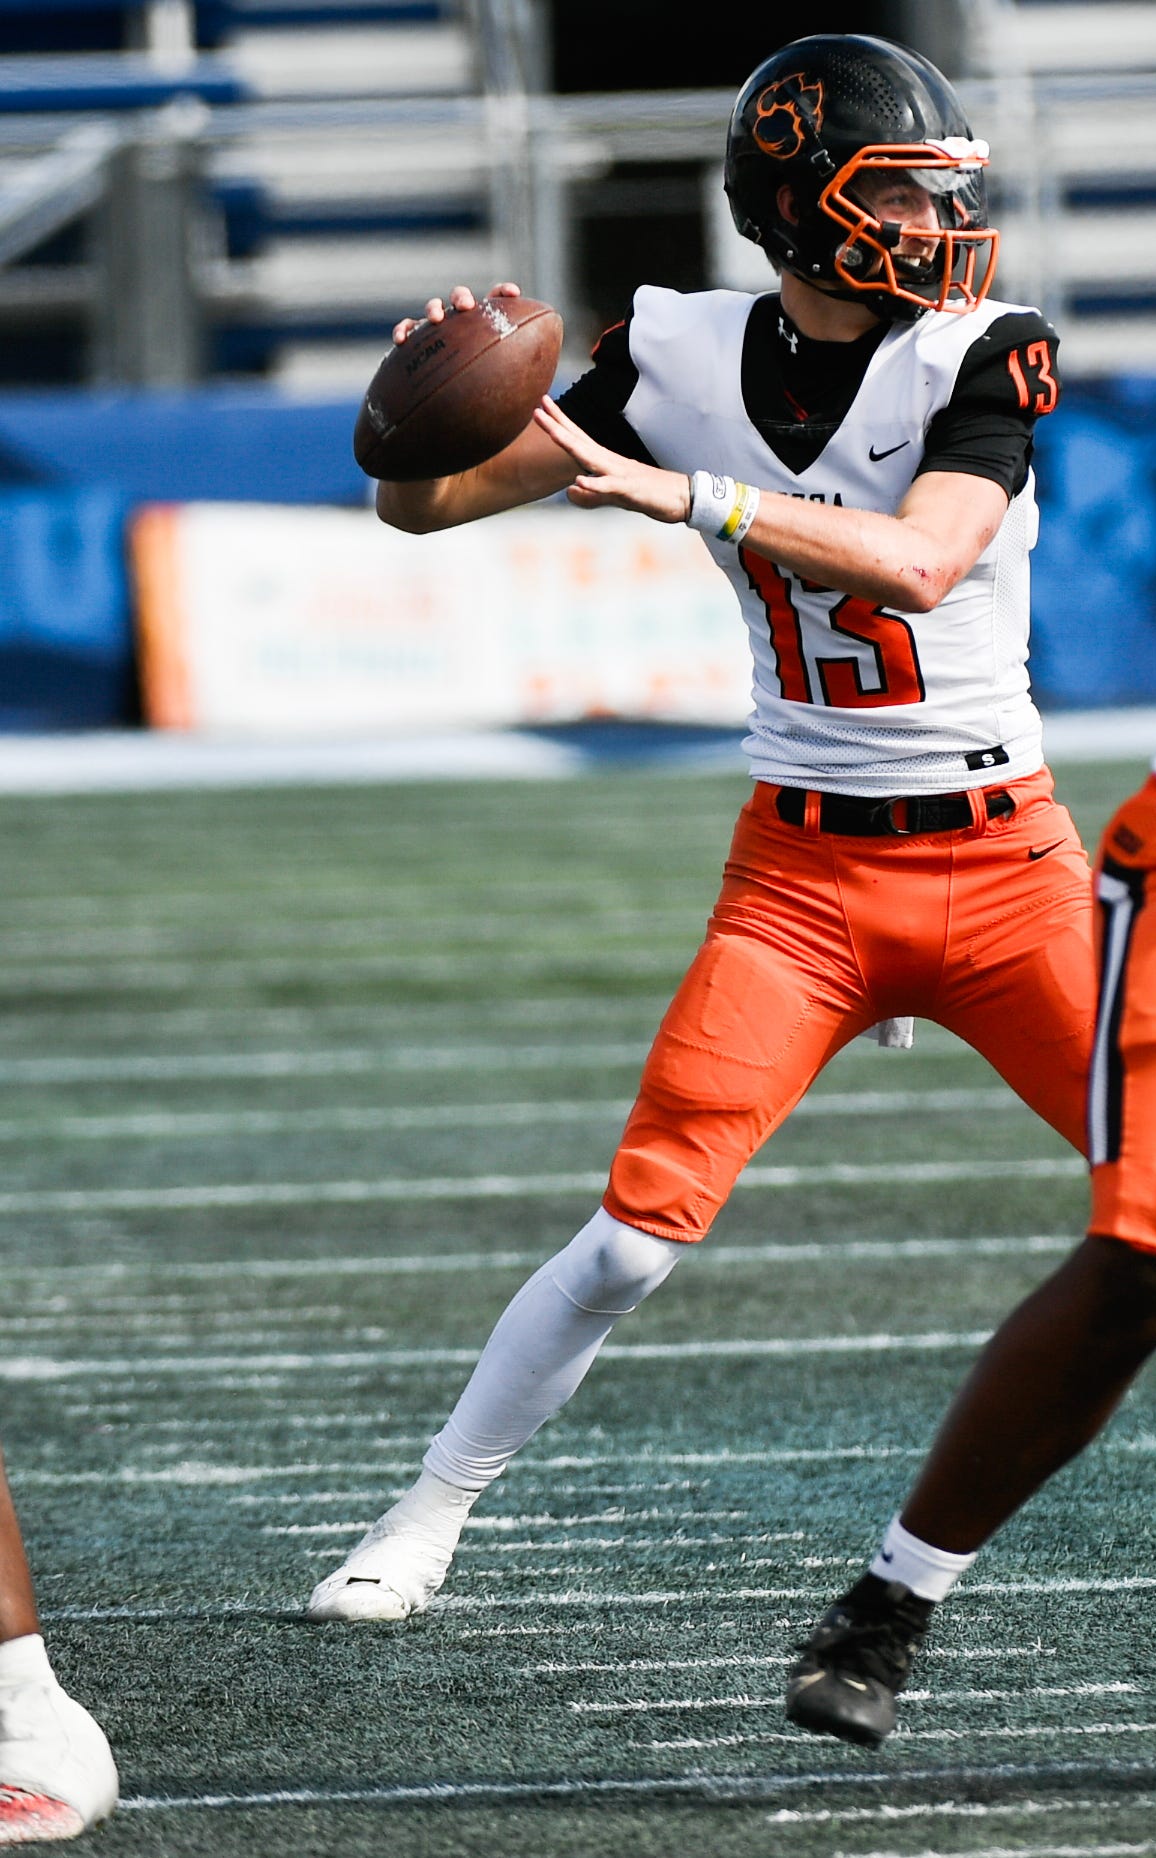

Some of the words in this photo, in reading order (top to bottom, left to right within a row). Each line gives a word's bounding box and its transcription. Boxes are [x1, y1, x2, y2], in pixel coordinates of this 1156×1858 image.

[1008, 340, 1058, 414] 13
[737, 544, 926, 709] 13
[981, 753, 996, 767] S
